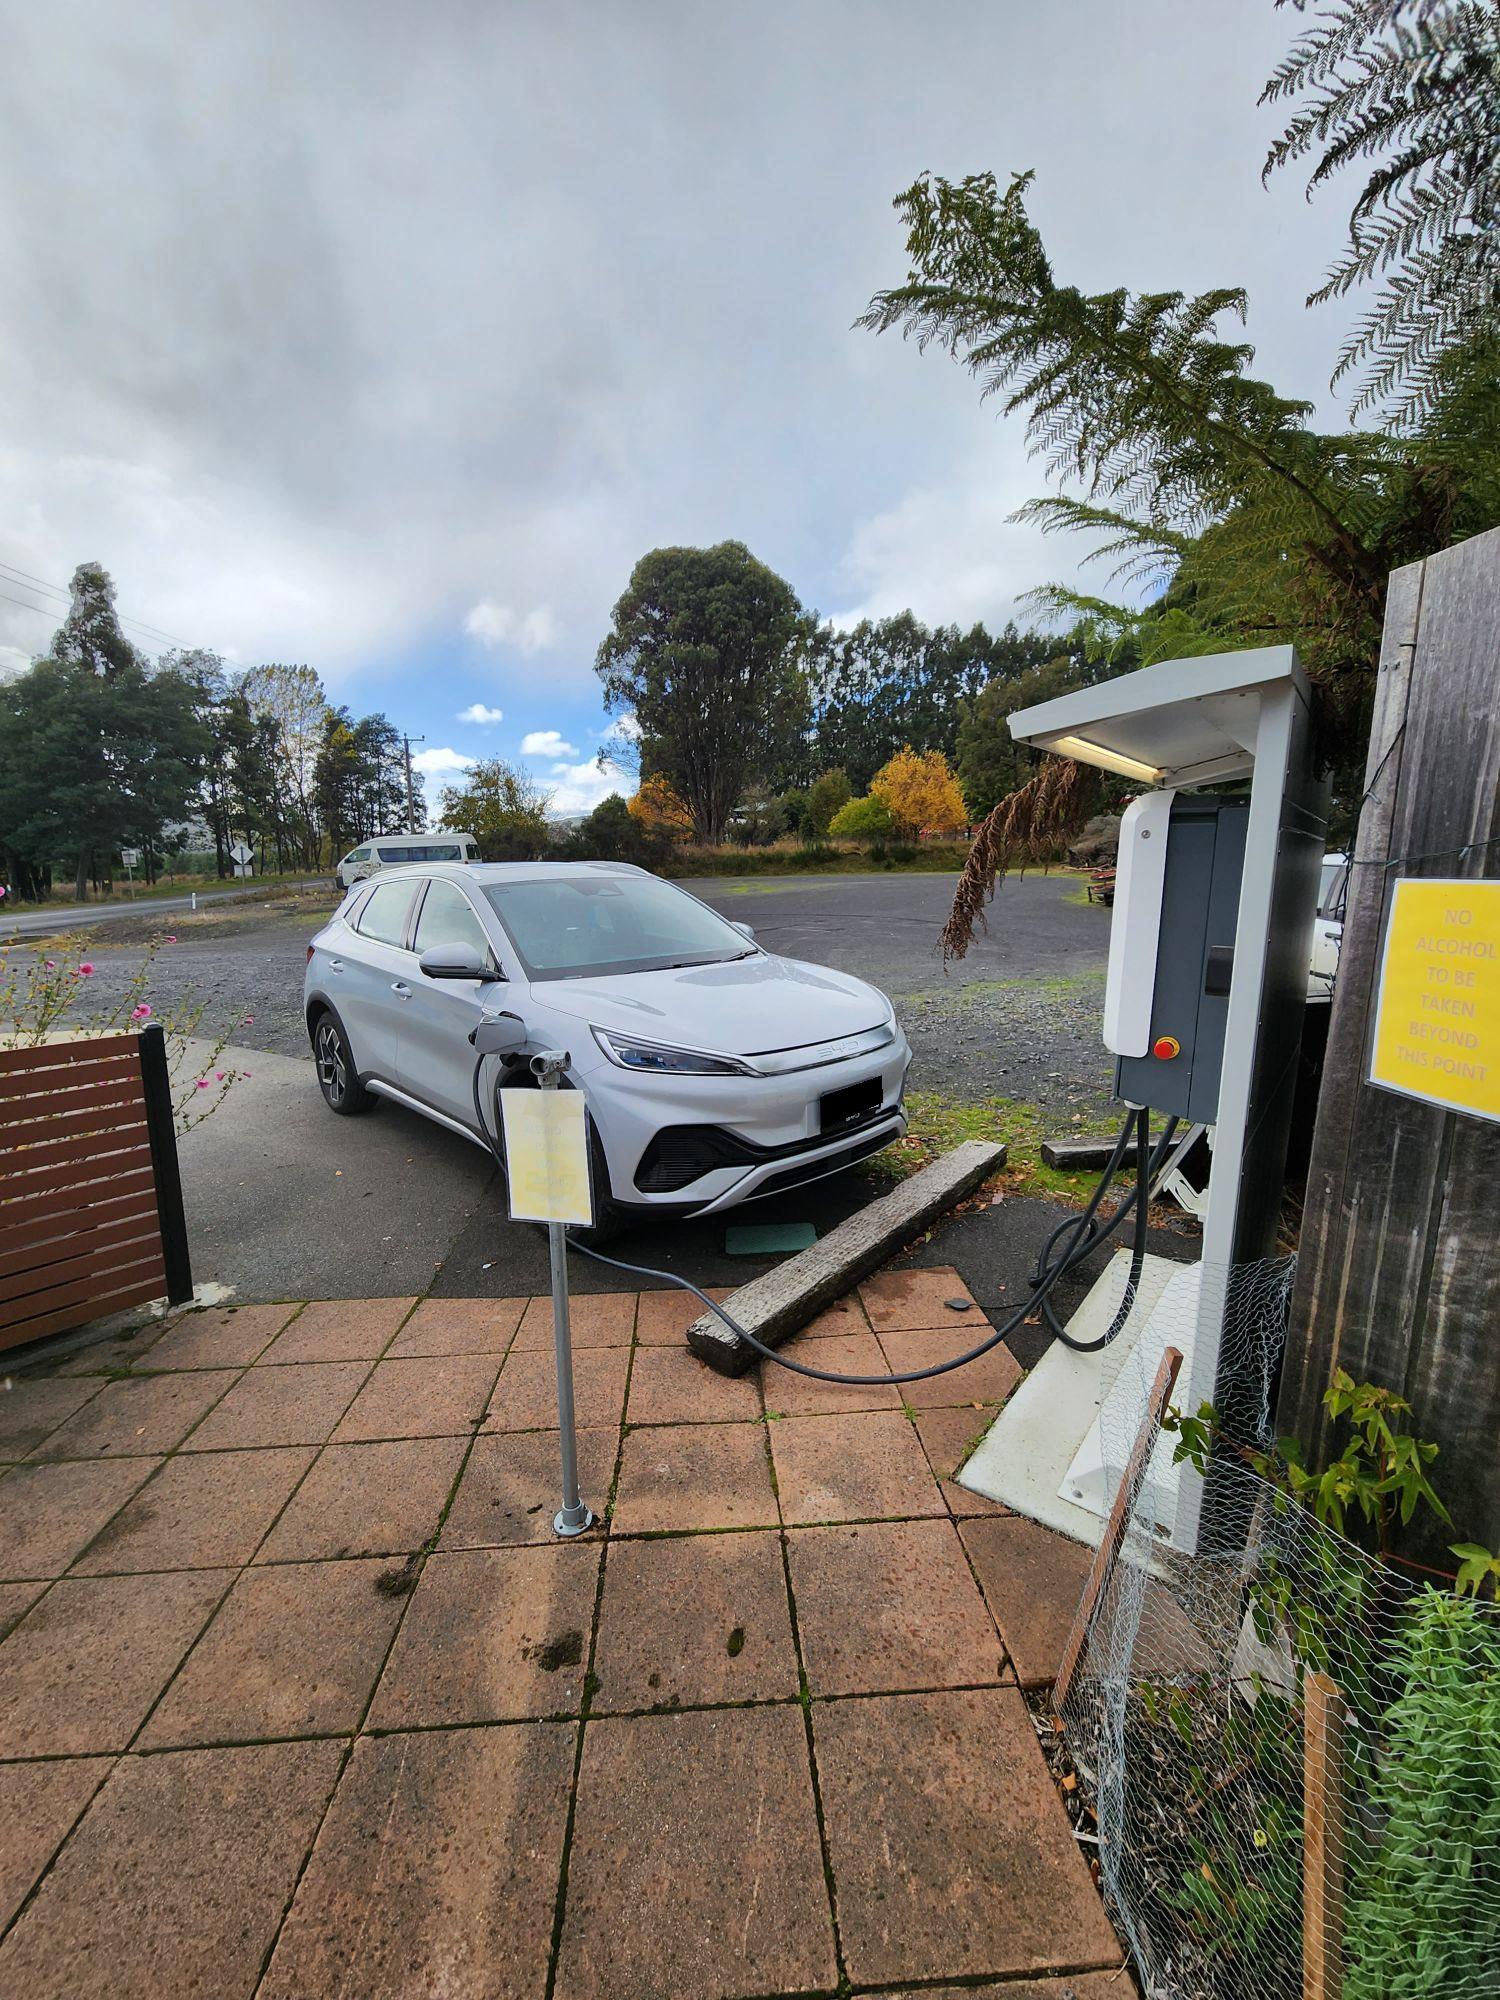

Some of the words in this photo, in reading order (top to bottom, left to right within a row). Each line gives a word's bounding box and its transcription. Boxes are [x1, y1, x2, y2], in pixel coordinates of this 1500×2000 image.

[1444, 909, 1473, 925] NO
[1416, 936, 1497, 959] ALCOHOL
[1427, 966, 1449, 983] TO
[1454, 971, 1476, 988] BE
[1421, 994, 1475, 1018] TAKEN
[1409, 1021, 1479, 1048] BEYOND
[1397, 1046, 1428, 1066] THIS
[1433, 1057, 1488, 1081] POINT
